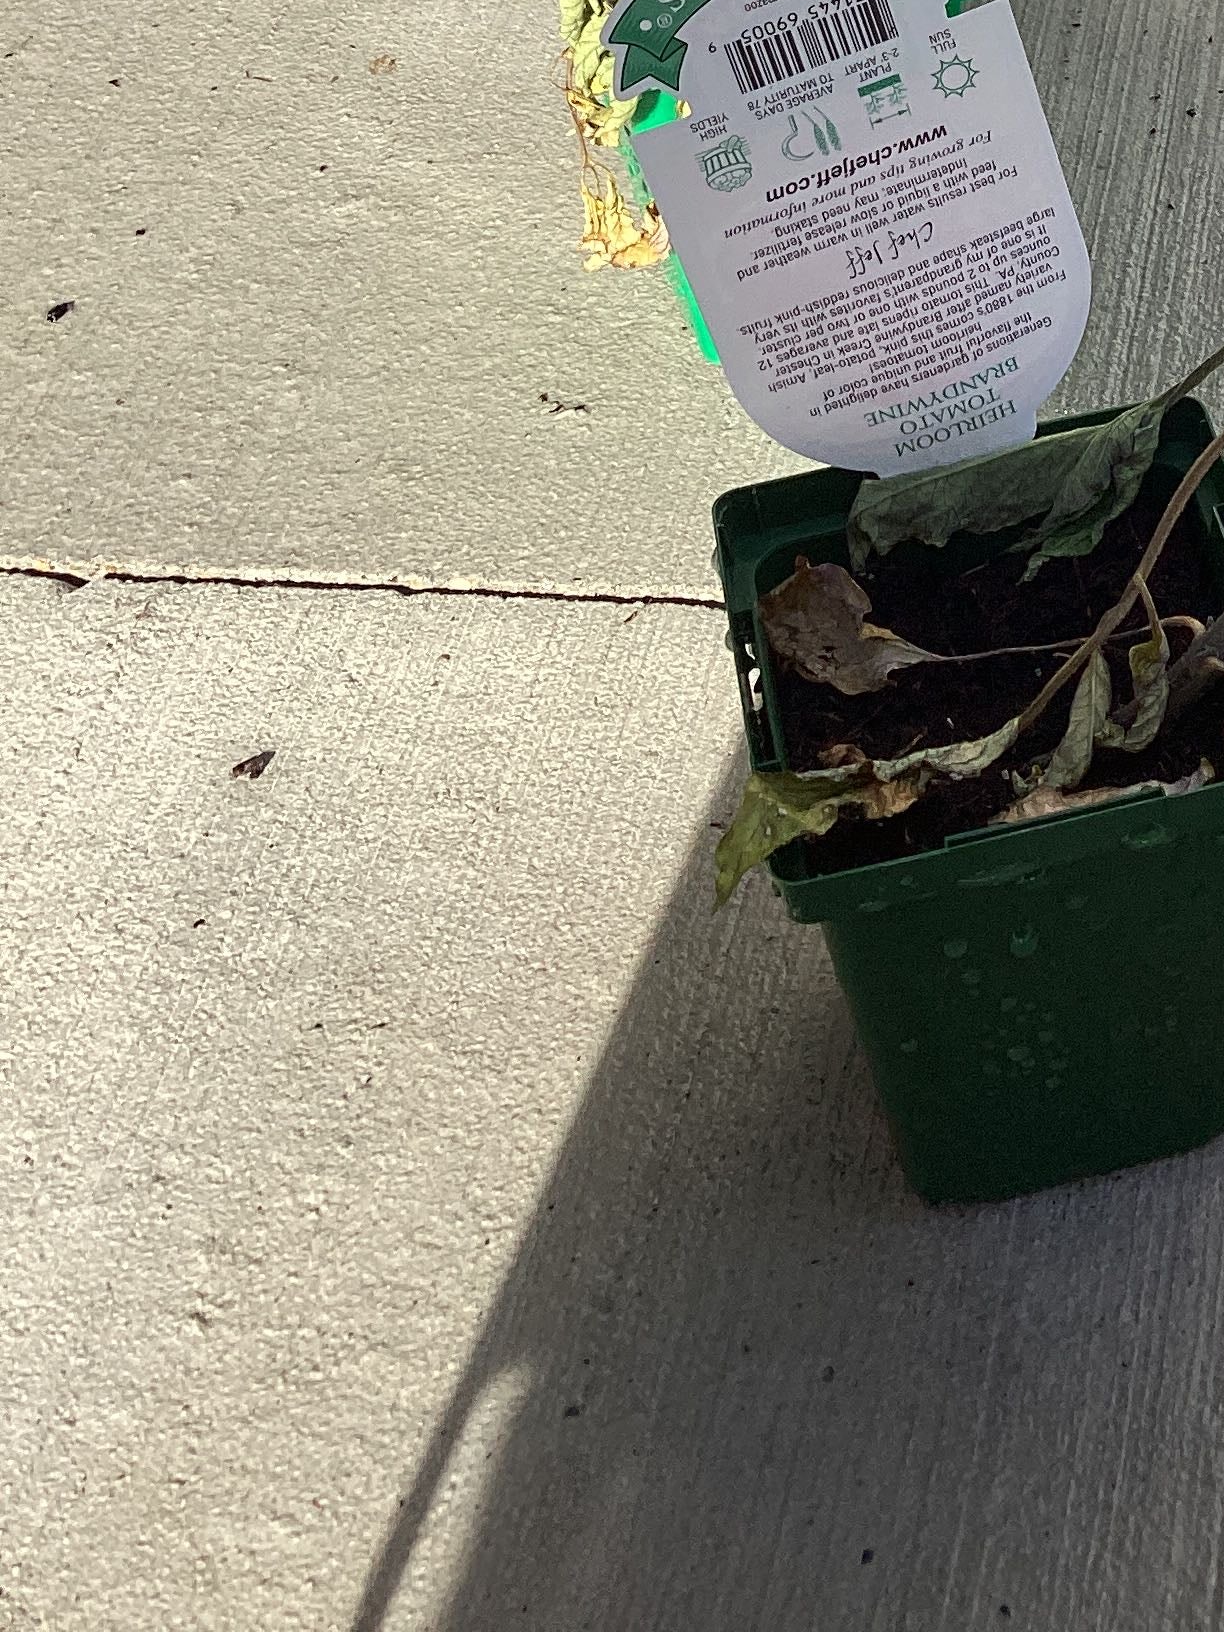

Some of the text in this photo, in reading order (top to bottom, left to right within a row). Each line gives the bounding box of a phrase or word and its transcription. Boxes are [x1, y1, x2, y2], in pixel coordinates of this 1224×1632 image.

[740, 11, 798, 44] 69005
[928, 28, 951, 44] SUN
[707, 41, 717, 53] 9
[930, 37, 956, 55] FULL
[843, 55, 877, 76] APART
[858, 61, 891, 82] PLANT
[746, 71, 834, 111] TO MATURITY 78
[754, 83, 833, 120] AVERAGE DAYS
[689, 111, 728, 133] YIELDS
[698, 123, 727, 141] HIGH
[764, 123, 947, 204] www.chefjeff.com
[970, 159, 996, 179] feed
[723, 129, 992, 240] For growing tips and more information
[942, 171, 969, 189] with
[853, 190, 879, 209] may
[880, 199, 894, 213] or
[896, 185, 930, 208] liquid
[736, 164, 1017, 281] For best results water well in warm weather and
[821, 202, 851, 222] need
[849, 205, 878, 225] slow
[1025, 206, 1055, 226] large
[803, 217, 847, 242] release
[968, 220, 1024, 250] beefsteak
[843, 218, 935, 279] Chef Jeff
[931, 243, 967, 265] shape
[1009, 235, 1051, 259] ounces
[907, 258, 930, 276] and
[977, 261, 990, 273] to
[991, 253, 1007, 266] up
[753, 223, 1047, 345] It is one of my grandparent's favorites with its very
[852, 268, 905, 296] delicious
[920, 271, 965, 298] pounds
[966, 267, 976, 280] 2
[1035, 269, 1066, 289] From
[964, 276, 990, 294] This
[1015, 283, 1034, 298] the
[773, 288, 850, 325] reddish-pink
[868, 302, 890, 317] one
[893, 291, 920, 309] with
[921, 288, 963, 312] tomato
[975, 293, 1013, 316] 1880's
[774, 262, 1052, 378] variety named after Brandywine Creek in Chester
[826, 316, 850, 332] two
[852, 311, 865, 324] or
[881, 305, 918, 327] ripens
[935, 311, 974, 334] comes
[804, 323, 824, 340] per
[831, 328, 854, 345] and
[857, 320, 879, 336] late
[910, 328, 934, 345] this
[930, 321, 982, 349] heirloom
[775, 336, 829, 363] averages
[821, 311, 1032, 401] the flavorful fruit and unique color of
[756, 357, 773, 371] 12
[808, 315, 1052, 418] Generations of gardeners have delighted in
[767, 371, 806, 393] Amish
[863, 356, 1019, 428] BRANDYWINE
[899, 387, 1000, 436] TOMATO
[894, 399, 1016, 457] HEIRLOOM
